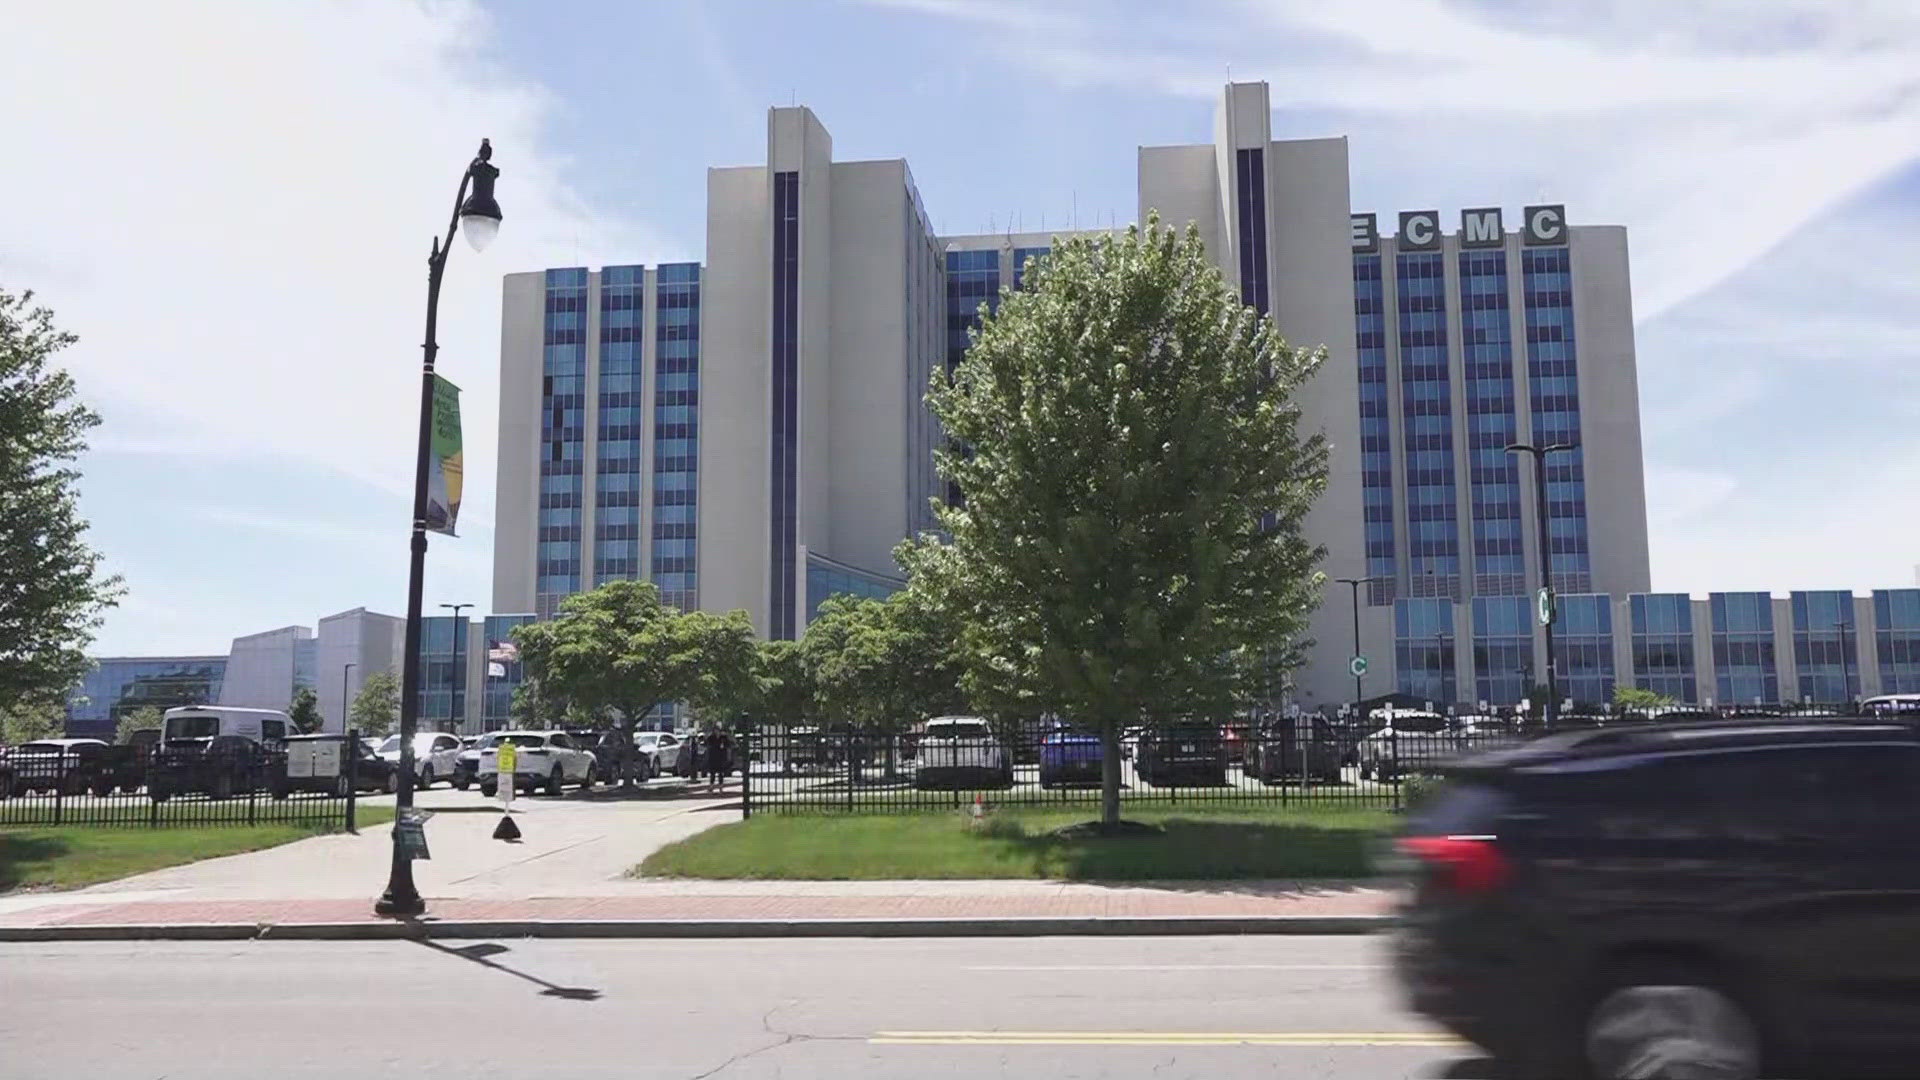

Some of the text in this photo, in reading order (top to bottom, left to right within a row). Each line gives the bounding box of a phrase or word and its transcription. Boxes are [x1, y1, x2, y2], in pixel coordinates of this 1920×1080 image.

[1351, 210, 1560, 246] ECMC
[1539, 591, 1549, 622] C
[1351, 657, 1366, 676] C
